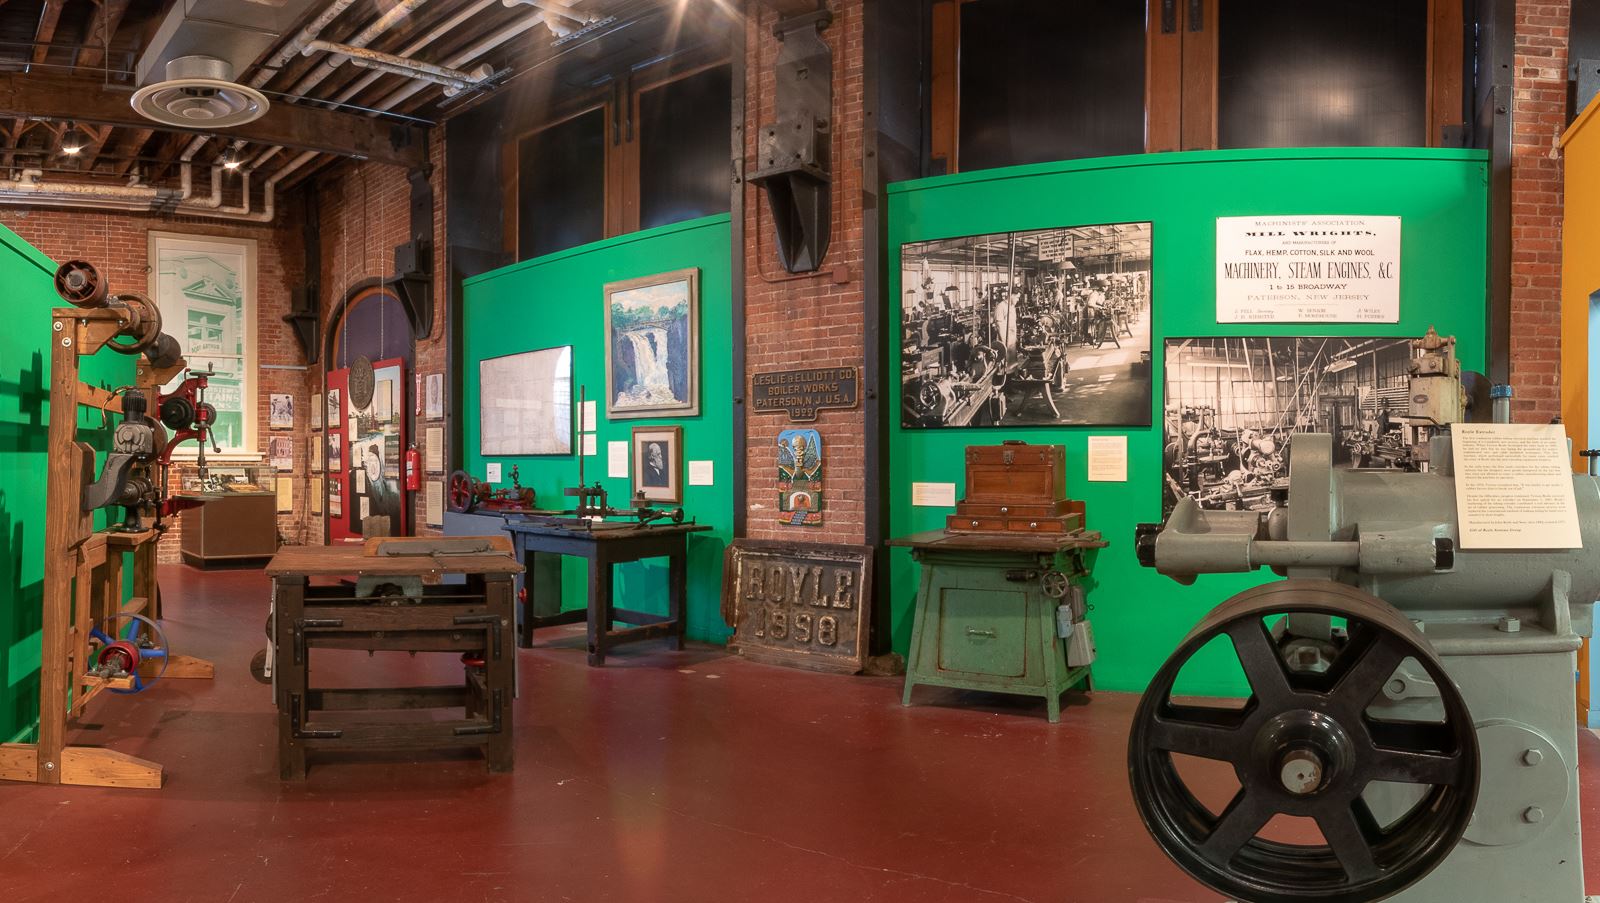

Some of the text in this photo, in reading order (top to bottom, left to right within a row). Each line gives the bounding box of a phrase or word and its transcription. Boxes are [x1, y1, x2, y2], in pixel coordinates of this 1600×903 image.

[1288, 262, 1321, 279] STEAM
[754, 374, 786, 386] LESLIE
[788, 375, 795, 383] &
[795, 370, 835, 382] ELLIOTT
[768, 382, 838, 396] BOILER WORKS
[745, 562, 854, 610] ROYLE
[754, 607, 838, 646] 1898
